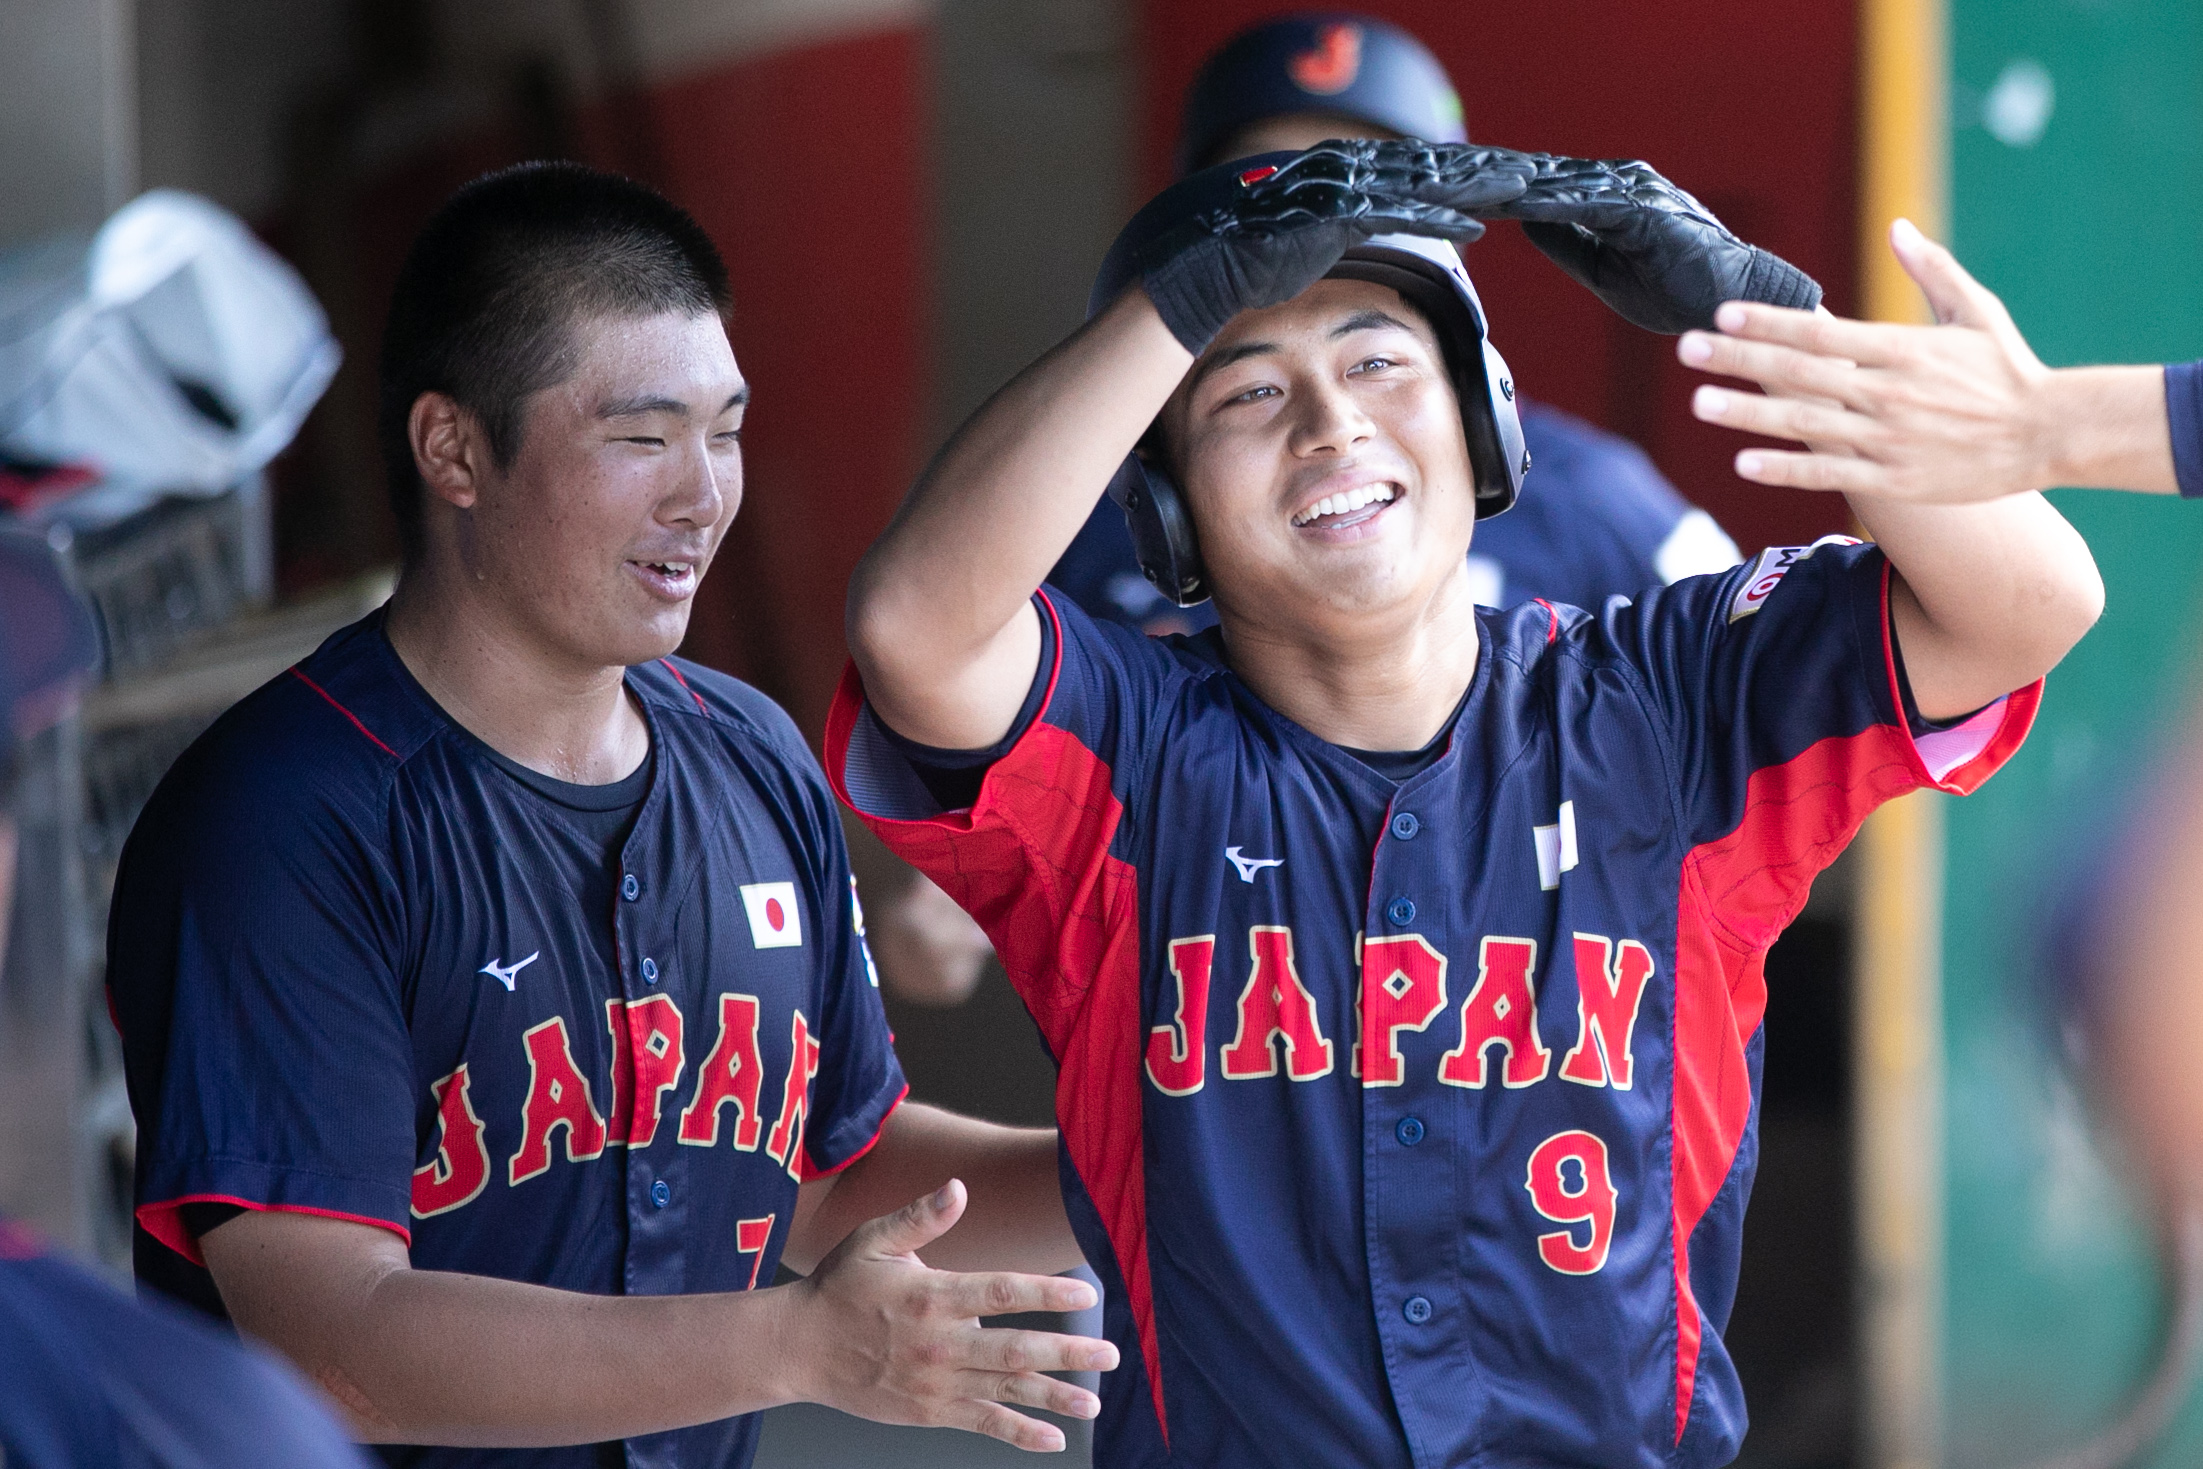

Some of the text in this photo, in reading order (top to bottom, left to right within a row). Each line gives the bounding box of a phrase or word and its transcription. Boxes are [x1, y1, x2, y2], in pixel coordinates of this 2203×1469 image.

[1289, 23, 1361, 94] J
[1146, 925, 1655, 1096] JAPAN
[737, 1213, 775, 1291] 7
[1525, 1130, 1618, 1275] 9
